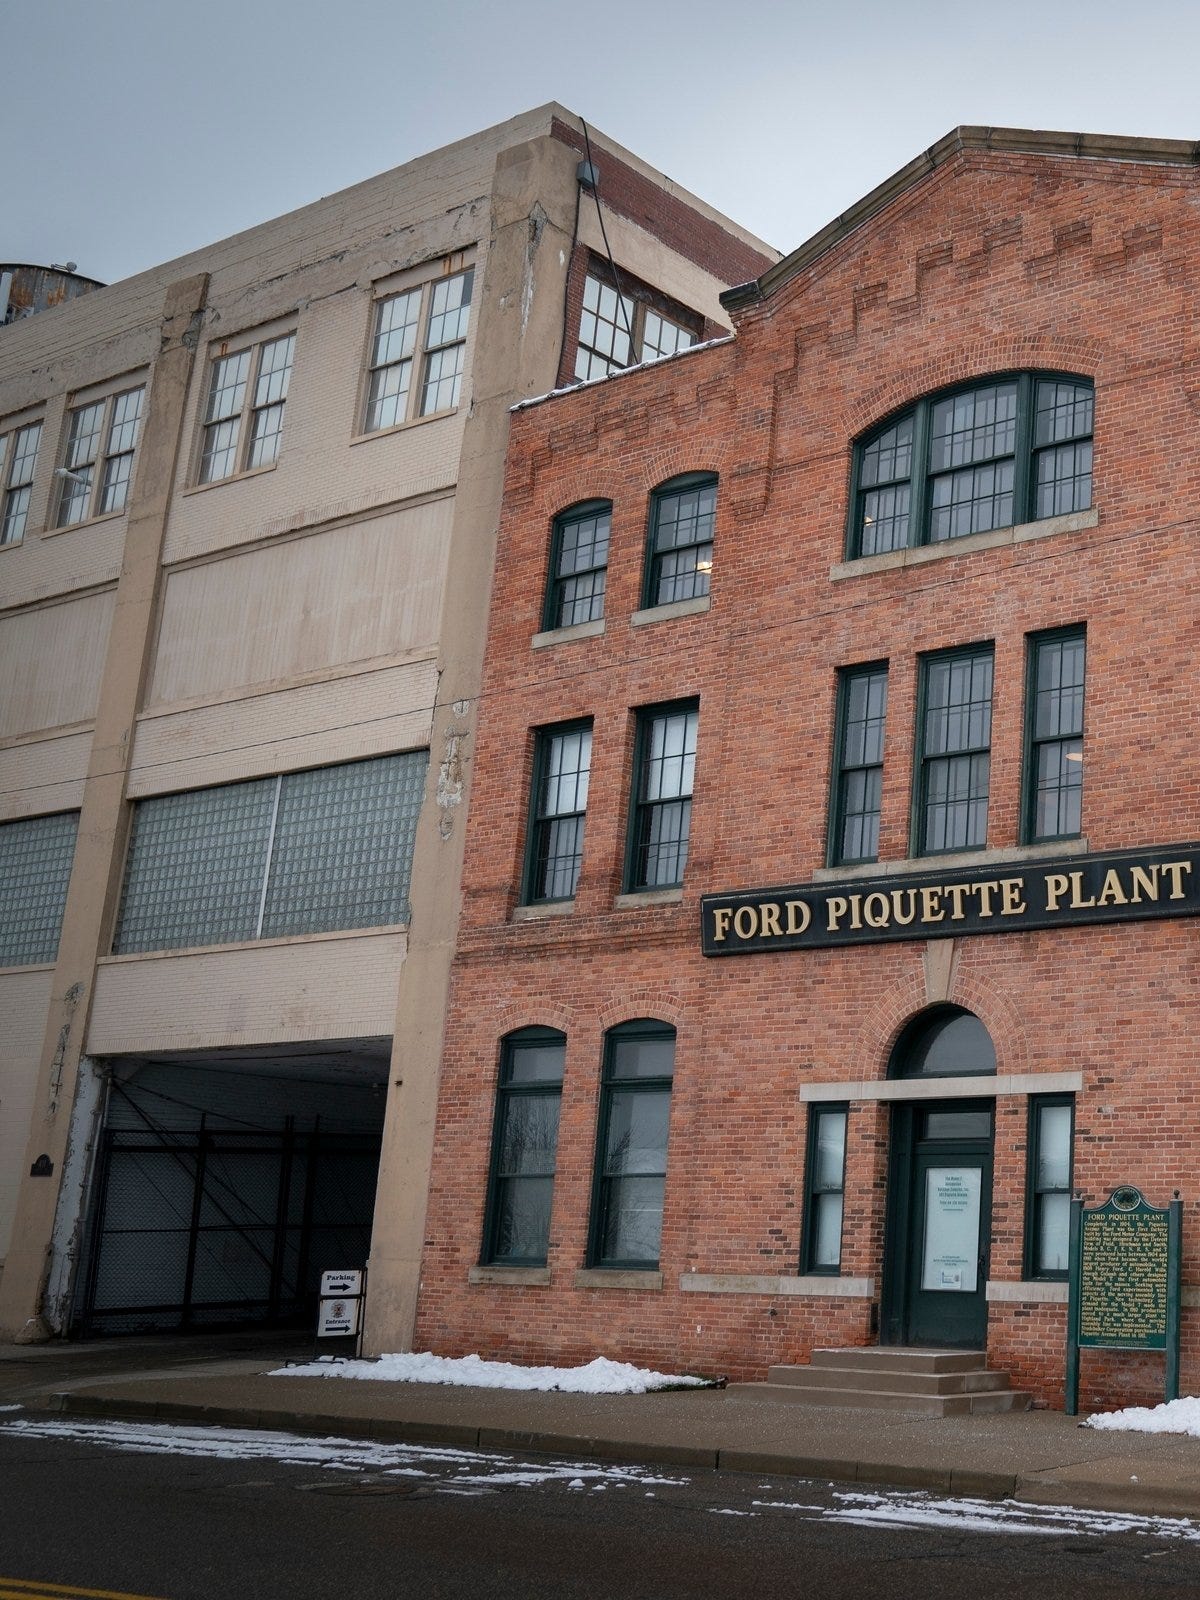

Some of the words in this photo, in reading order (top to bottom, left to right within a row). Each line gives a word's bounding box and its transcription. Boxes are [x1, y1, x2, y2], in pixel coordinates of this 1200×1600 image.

[713, 901, 811, 941] FORD
[826, 877, 1026, 931] PIQUETTE
[1045, 861, 1192, 911] PLANT
